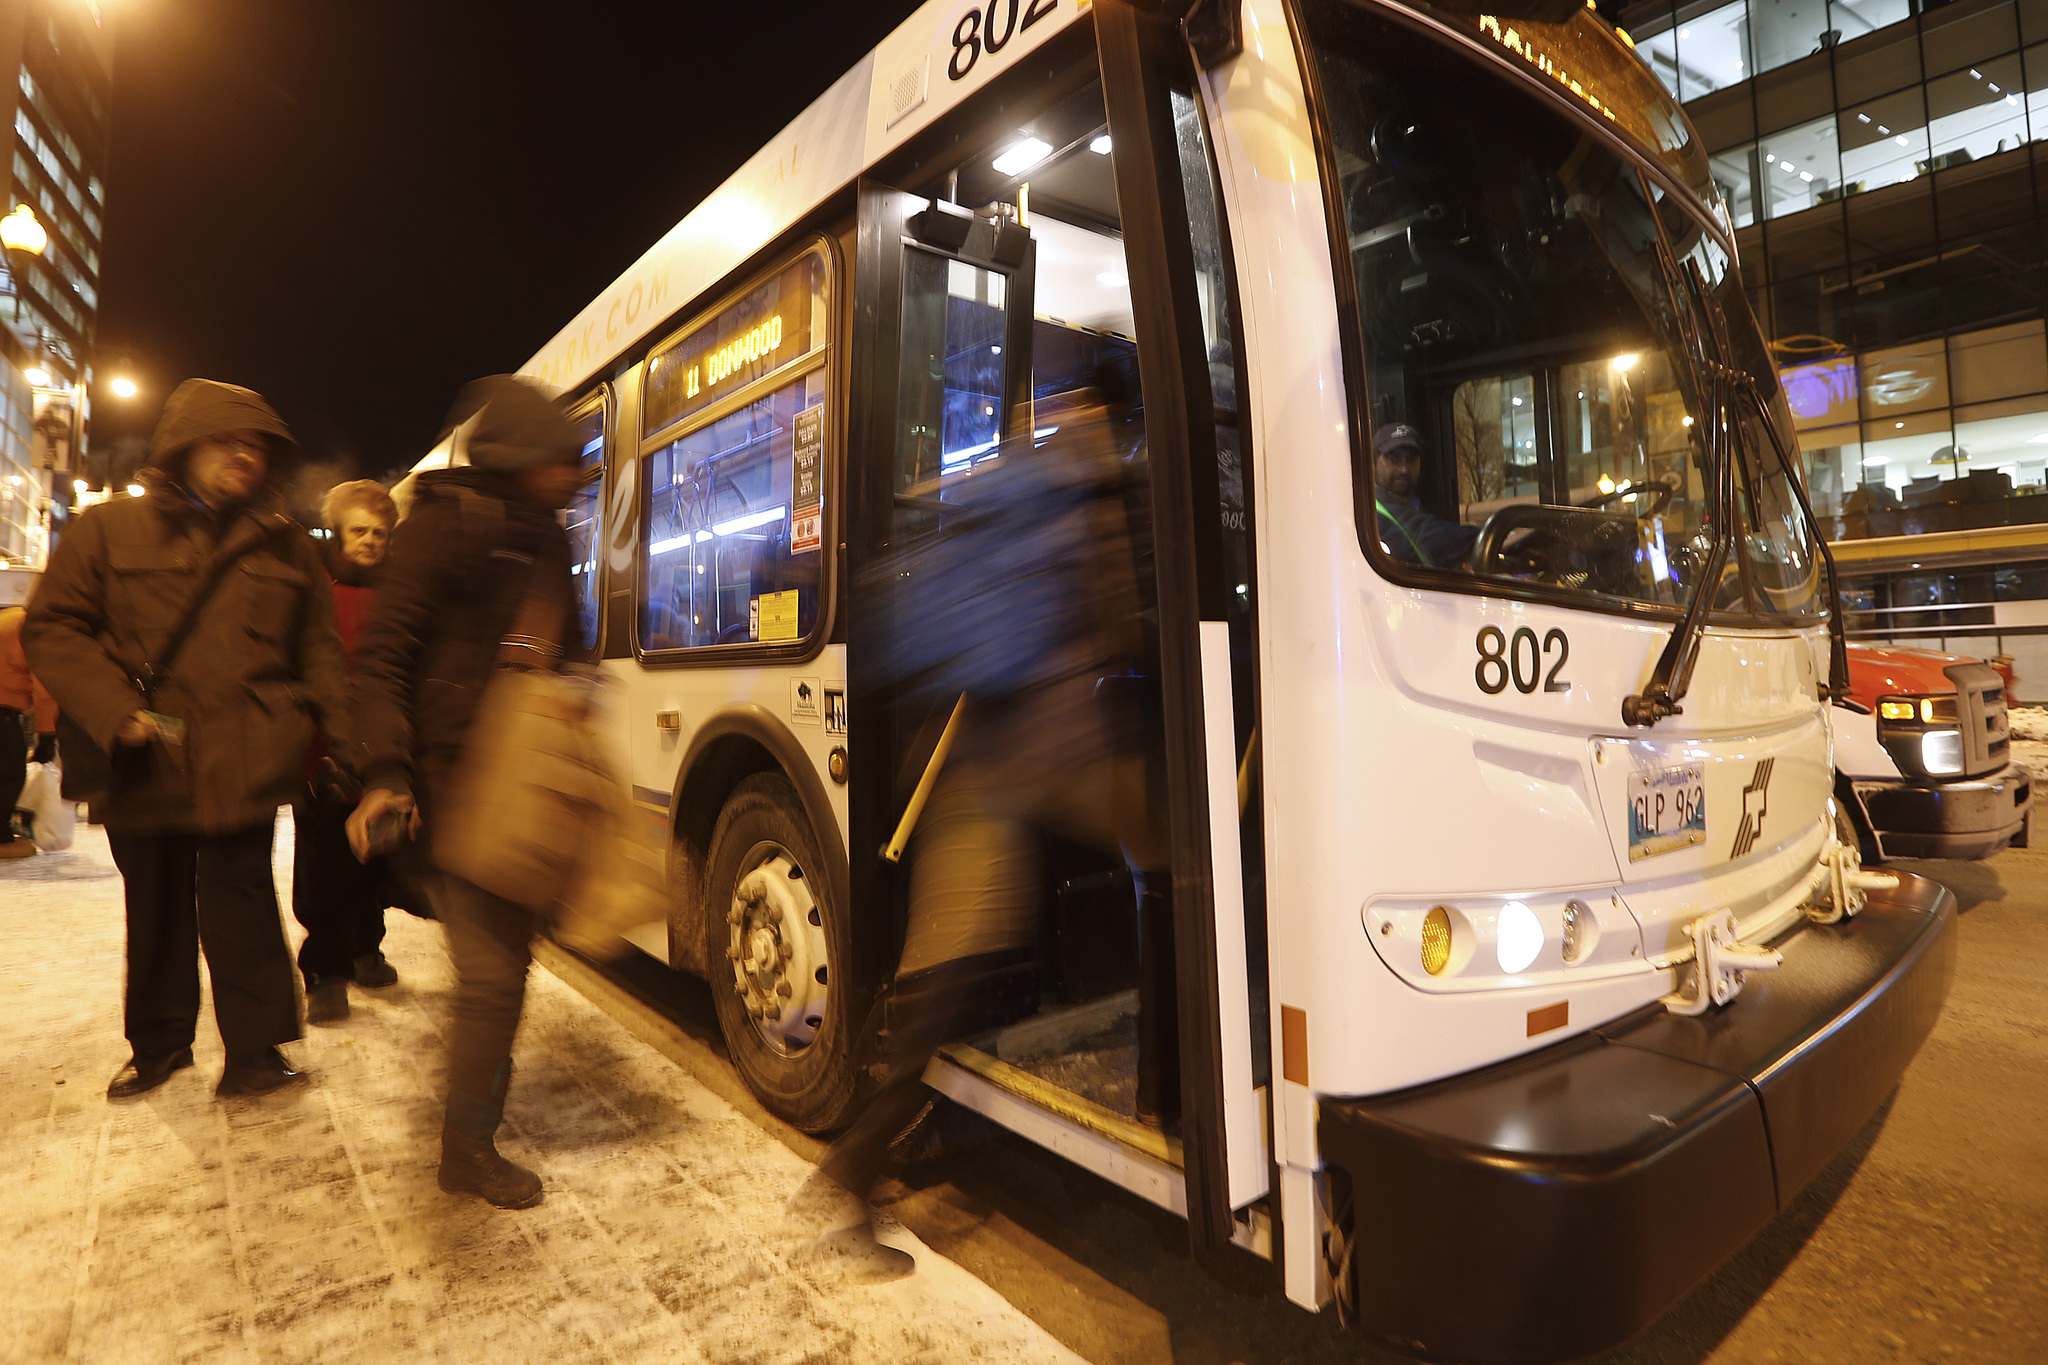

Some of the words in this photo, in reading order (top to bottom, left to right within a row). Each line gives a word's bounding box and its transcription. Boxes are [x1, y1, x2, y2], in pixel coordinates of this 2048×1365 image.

[687, 365, 700, 399] 11
[1475, 624, 1572, 695] 802
[1635, 792, 1665, 836] GLP
[1676, 786, 1704, 828] 962
